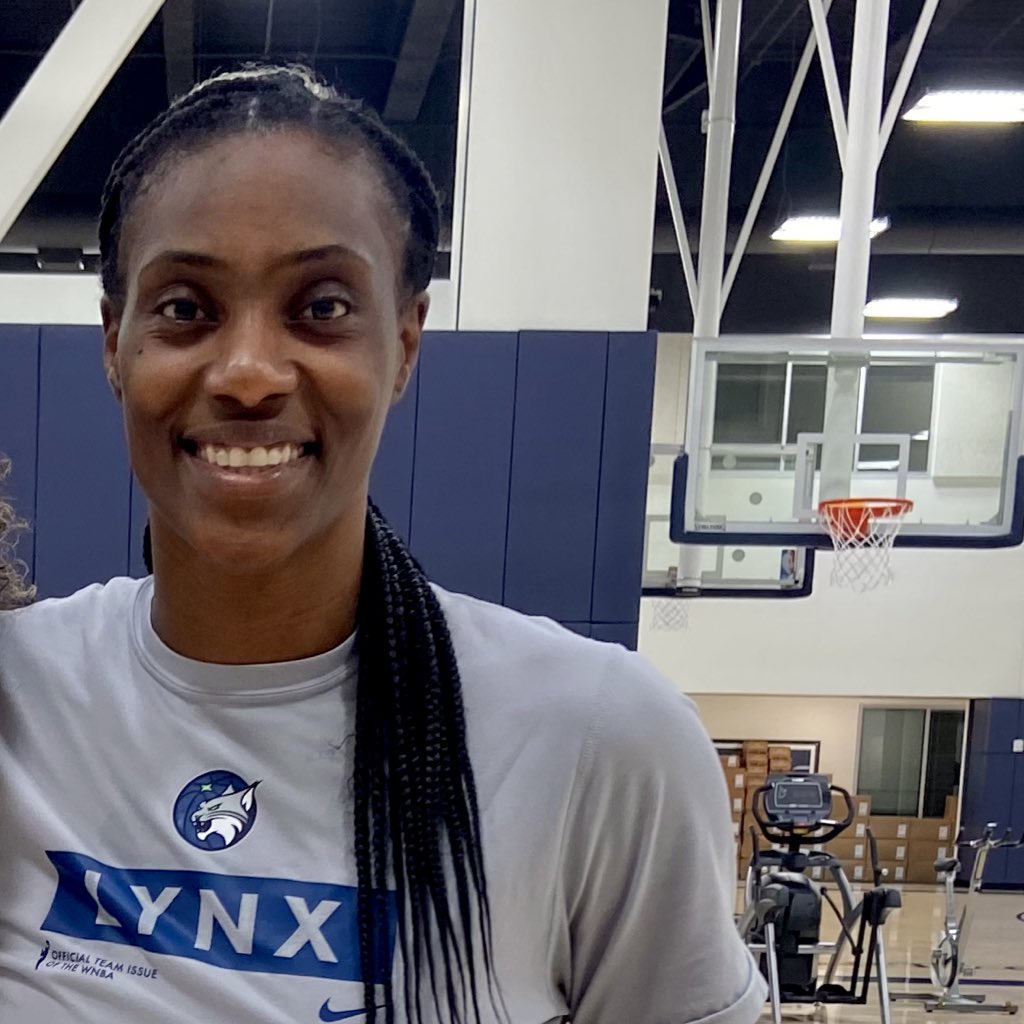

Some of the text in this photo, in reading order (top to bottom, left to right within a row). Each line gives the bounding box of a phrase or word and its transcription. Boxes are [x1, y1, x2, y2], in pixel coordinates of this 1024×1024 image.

[84, 870, 342, 963] LYNX
[51, 950, 158, 979] OFFICIAL TEAM ISSUE
[60, 962, 79, 972] THE
[81, 965, 114, 980] WNBA
